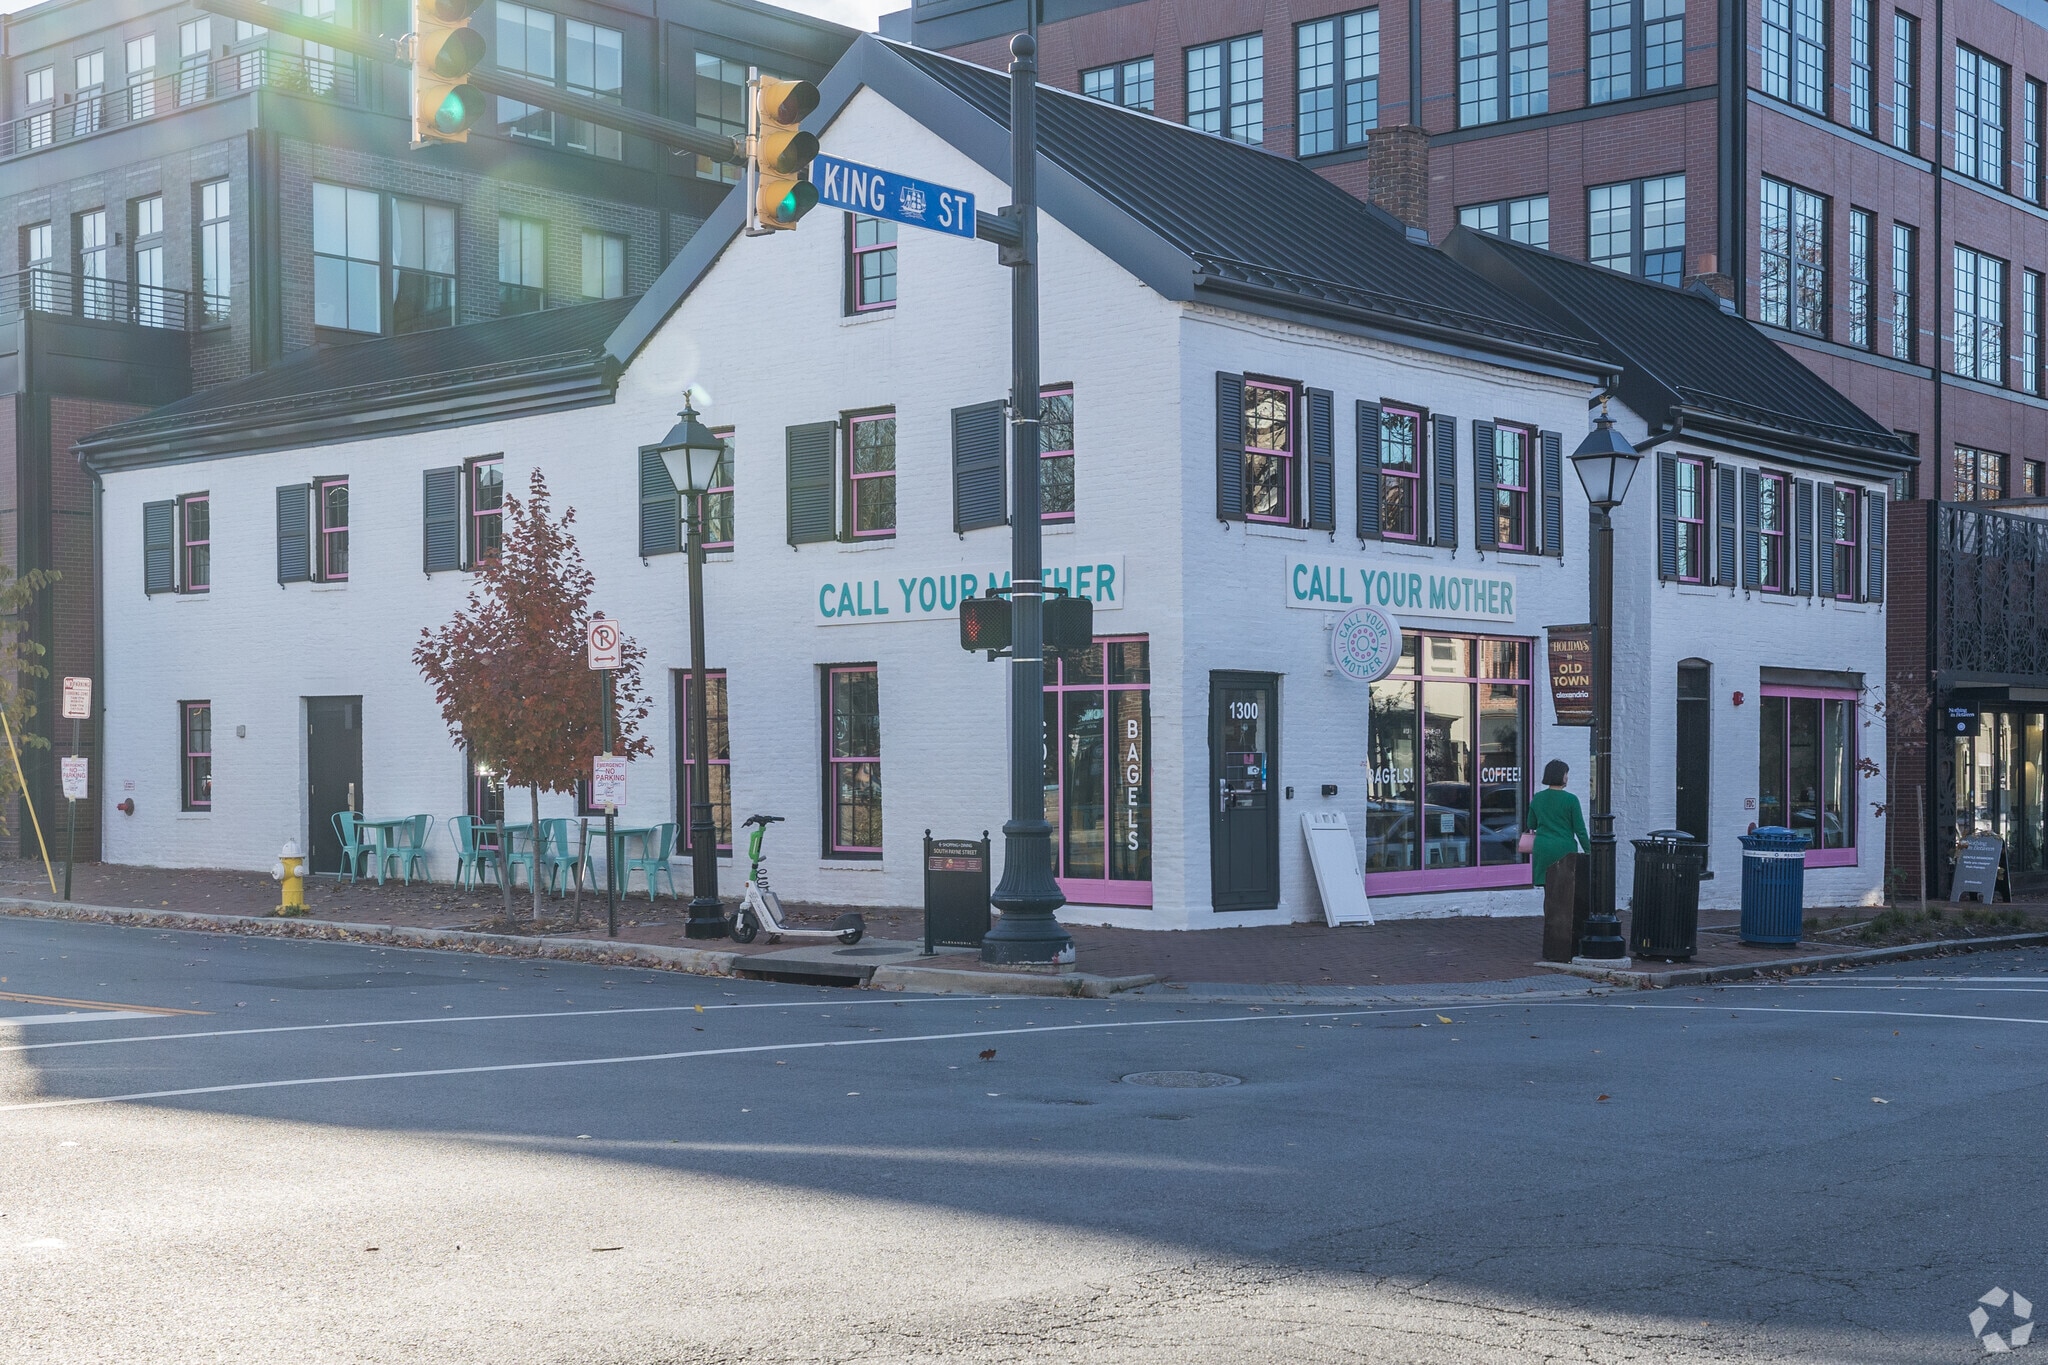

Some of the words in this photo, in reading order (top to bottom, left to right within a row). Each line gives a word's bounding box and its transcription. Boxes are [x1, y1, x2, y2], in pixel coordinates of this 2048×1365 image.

[823, 162, 886, 212] KING
[938, 192, 967, 231] ST
[819, 579, 889, 617] CALL
[898, 573, 978, 613] YOUR
[989, 564, 1116, 602] MTHER
[1292, 563, 1353, 604] CALL
[1360, 568, 1422, 608] YOUR
[1429, 575, 1513, 615] MOTHER
[1339, 613, 1361, 638] CALL
[1366, 612, 1387, 637] YOUR
[1551, 640, 1589, 653] HOLIDAYS
[1341, 656, 1382, 675] MOTHER
[1559, 663, 1582, 674] OLD
[1553, 676, 1589, 686] TOWN
[1556, 690, 1589, 698] alexandria
[1229, 701, 1258, 719] 1300
[1126, 719, 1139, 850] BAGELS
[1368, 767, 1413, 784] BAGELS!
[1481, 767, 1521, 783] COFFEE!
